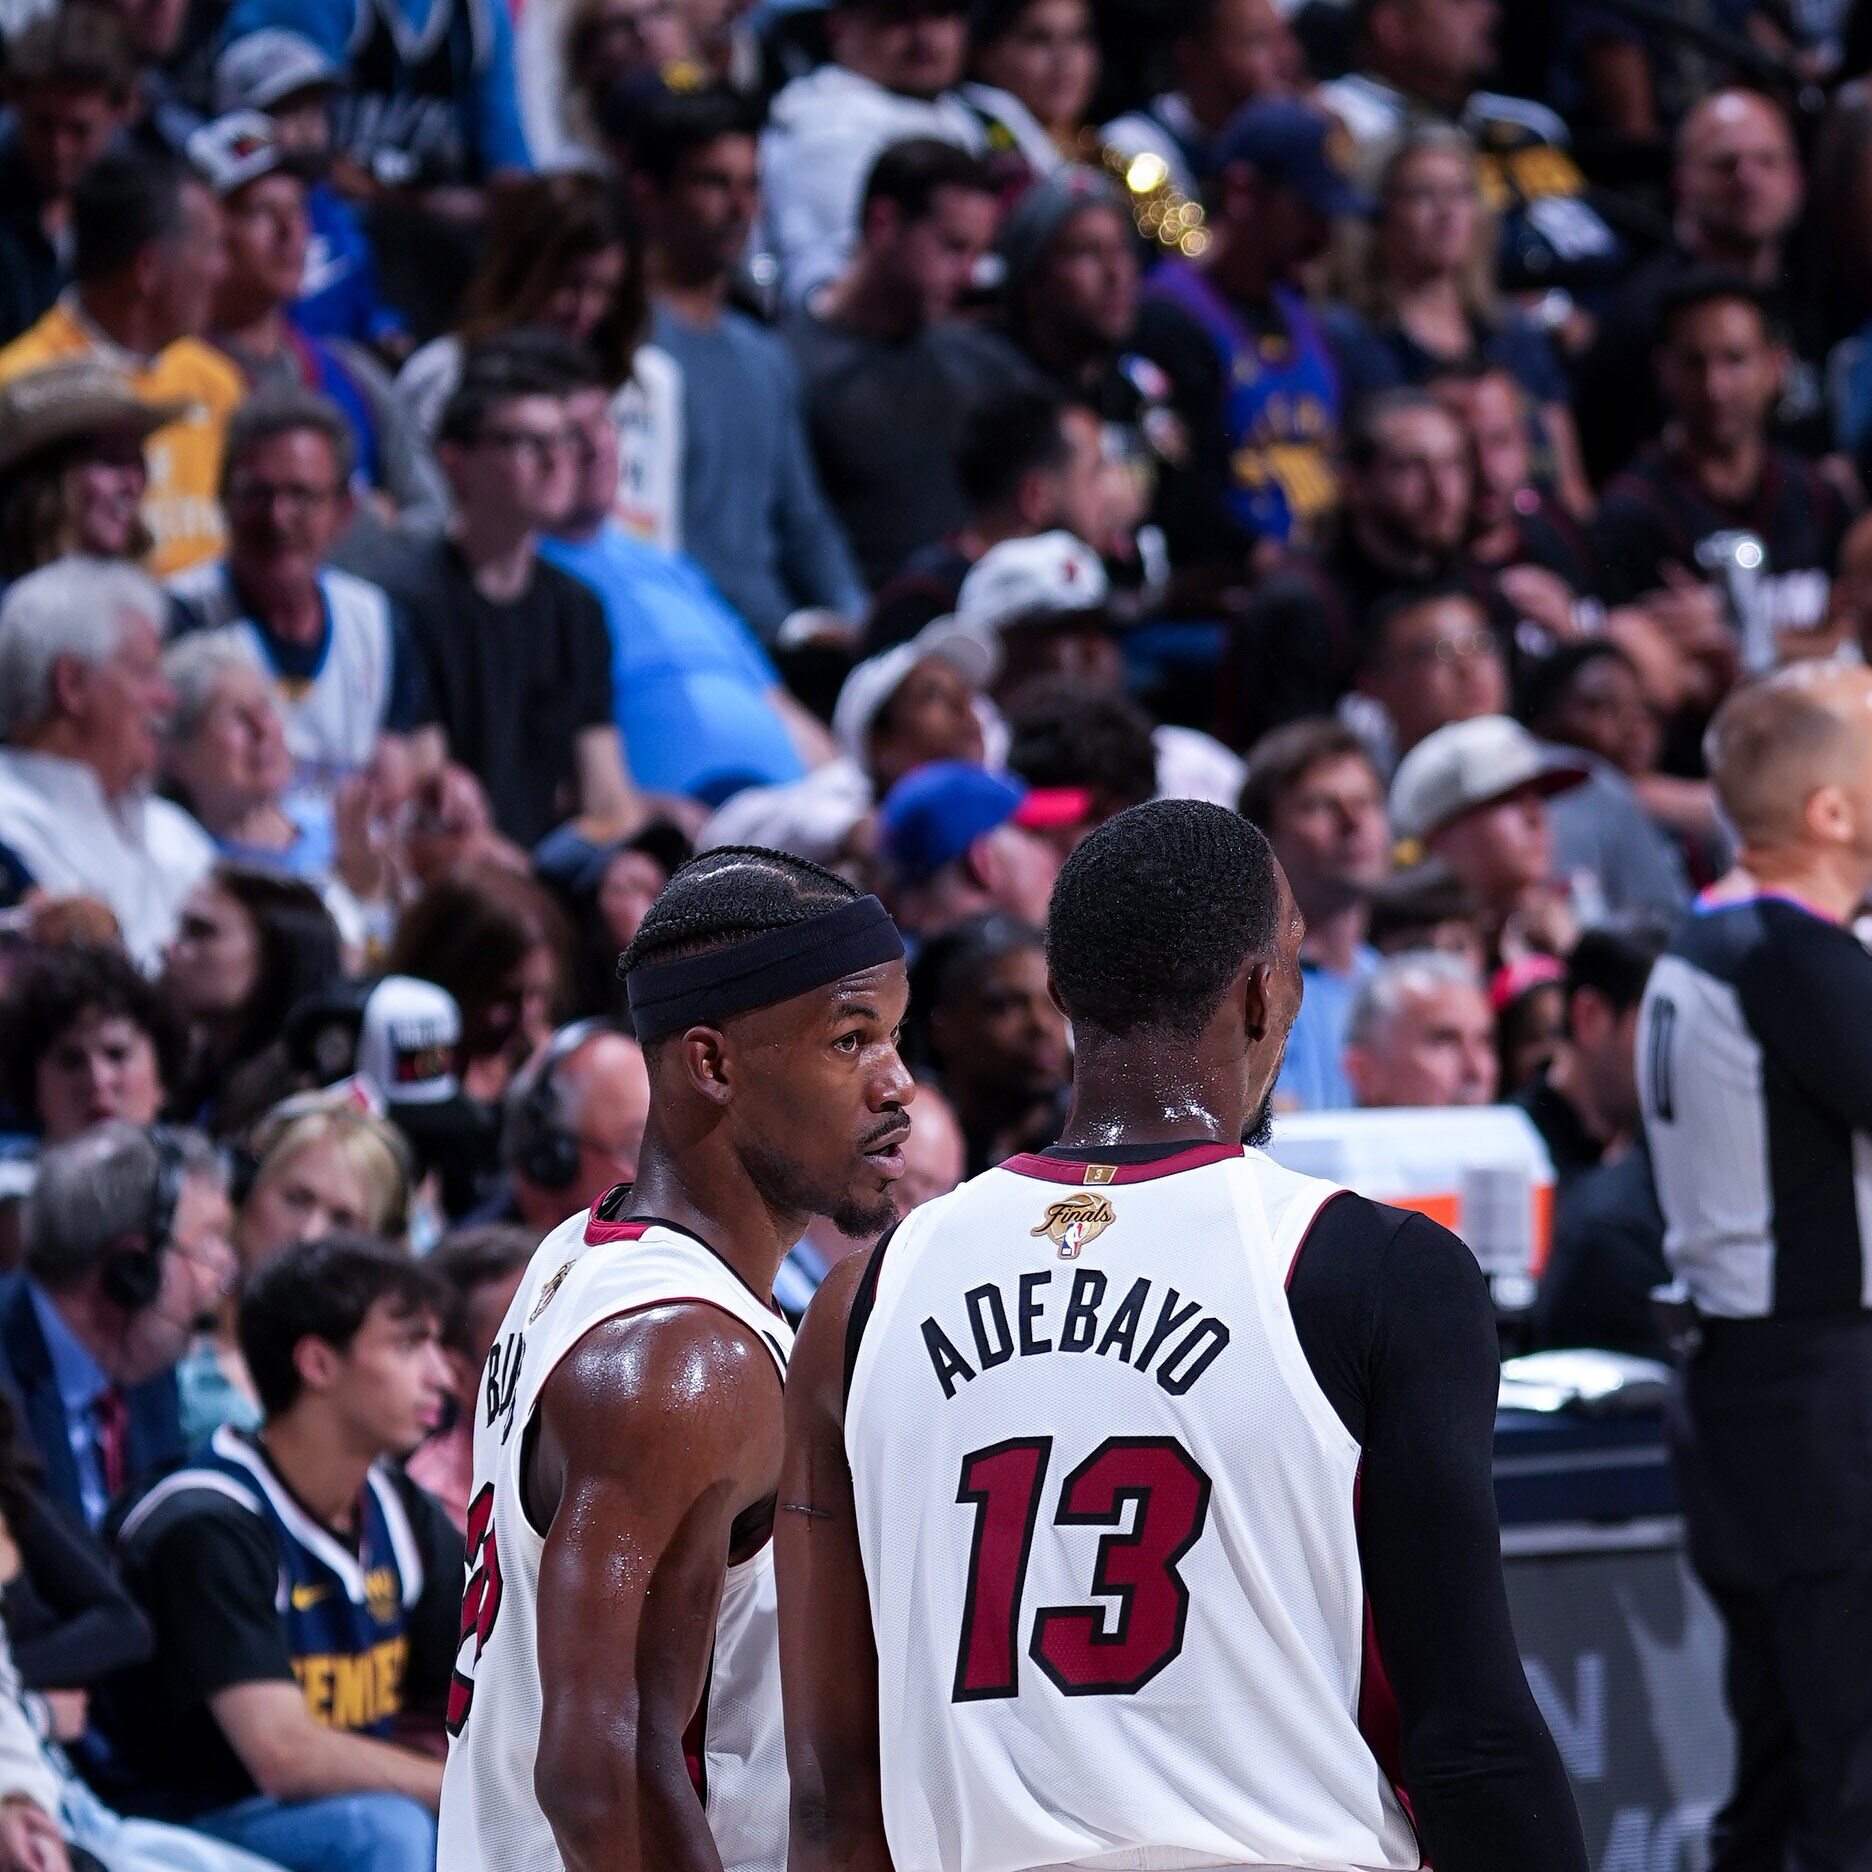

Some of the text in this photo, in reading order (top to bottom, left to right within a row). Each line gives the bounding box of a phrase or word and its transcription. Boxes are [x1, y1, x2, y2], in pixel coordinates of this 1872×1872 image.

[1093, 1168, 1103, 1180] 3
[1031, 1202, 1112, 1233] Finals
[920, 1268, 1230, 1400] ADEBAYO
[951, 1435, 1213, 1704] 13
